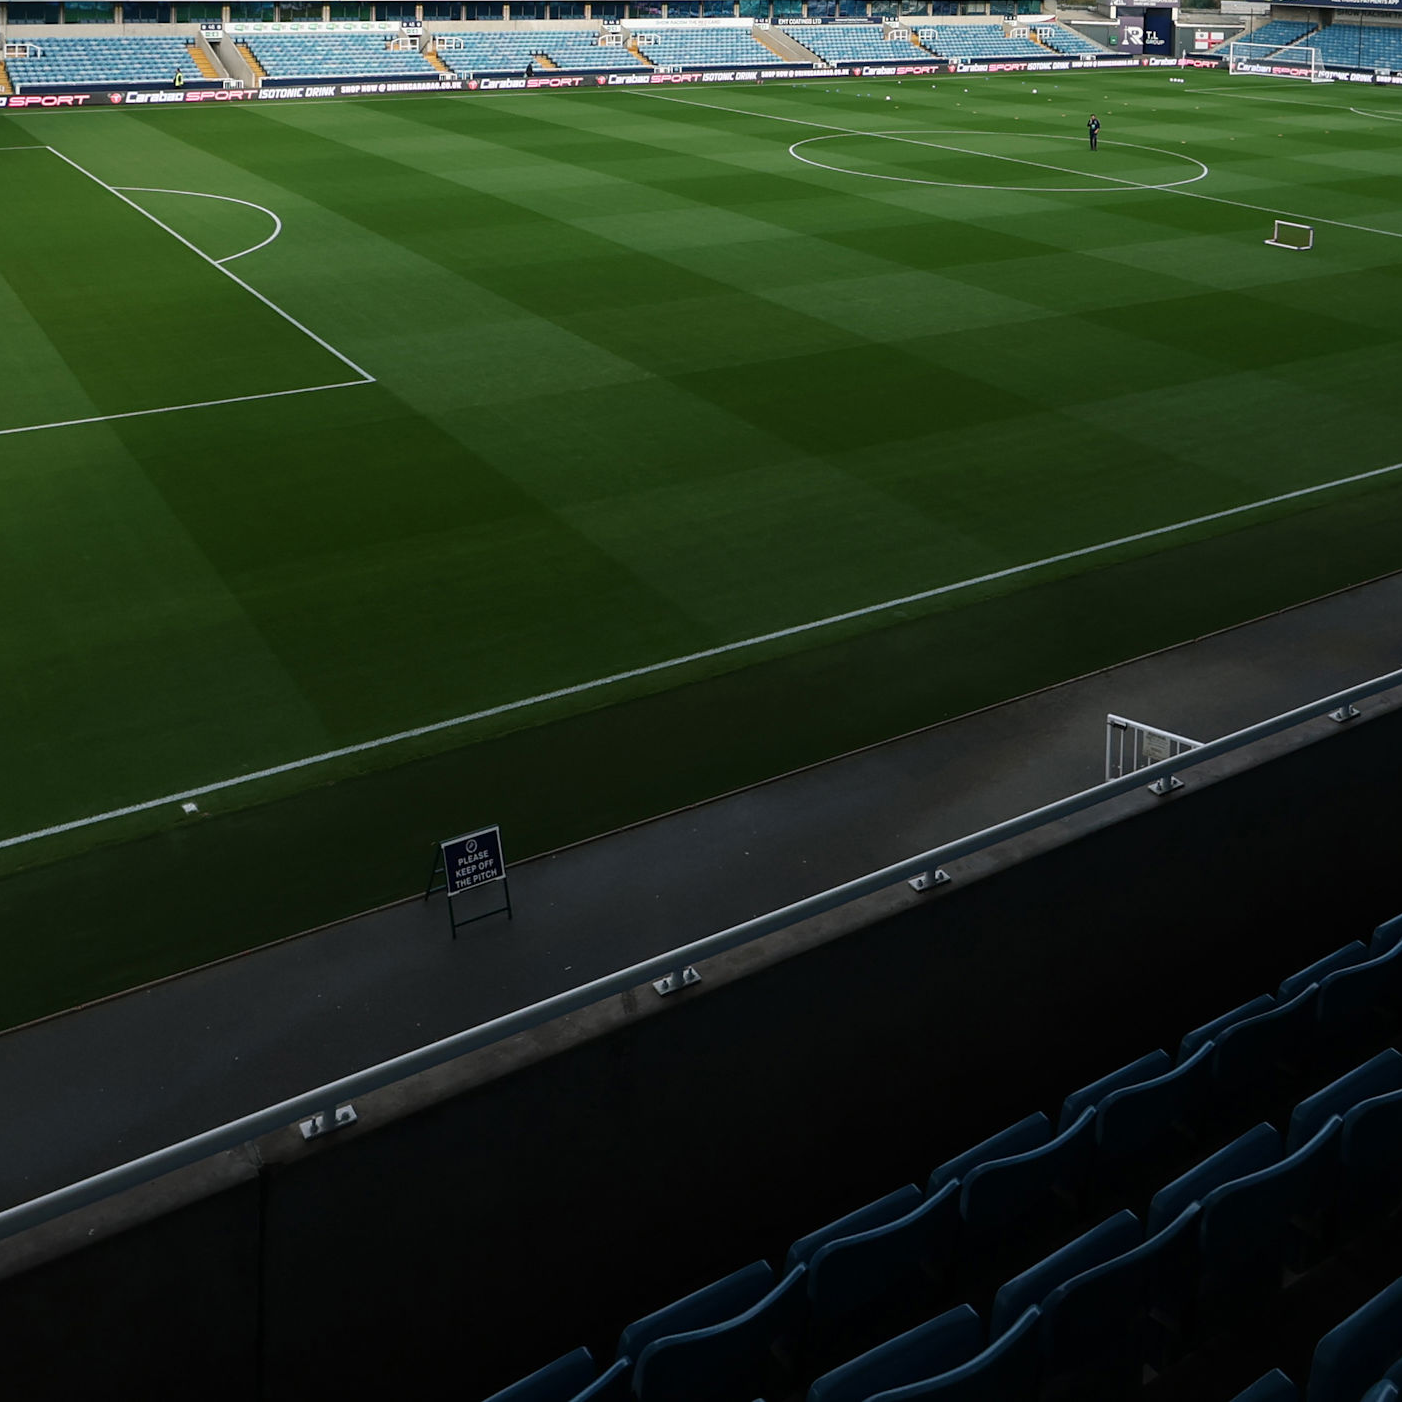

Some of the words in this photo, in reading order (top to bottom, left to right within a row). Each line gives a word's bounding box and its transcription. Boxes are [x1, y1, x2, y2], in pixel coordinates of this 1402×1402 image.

[862, 66, 896, 76] Carabao
[896, 66, 939, 75] SPORT
[988, 63, 1028, 72] SPORT
[480, 78, 526, 90] Carabao
[526, 77, 584, 89] SPORT
[608, 74, 650, 85] Carabao
[650, 74, 703, 84] SPORT
[702, 72, 734, 81] ISOTONIC
[735, 71, 758, 80] DRINK
[7, 94, 90, 107] SPORT
[125, 91, 184, 104] Carabao
[185, 90, 258, 102] SPORT
[258, 88, 302, 100] ISOTONIC
[305, 86, 336, 98] DRINK
[458, 849, 489, 866] PLEASE
[455, 865, 477, 879] KEEP
[478, 859, 494, 871] OFF
[455, 877, 472, 889] THE
[473, 868, 498, 883] PITCH
